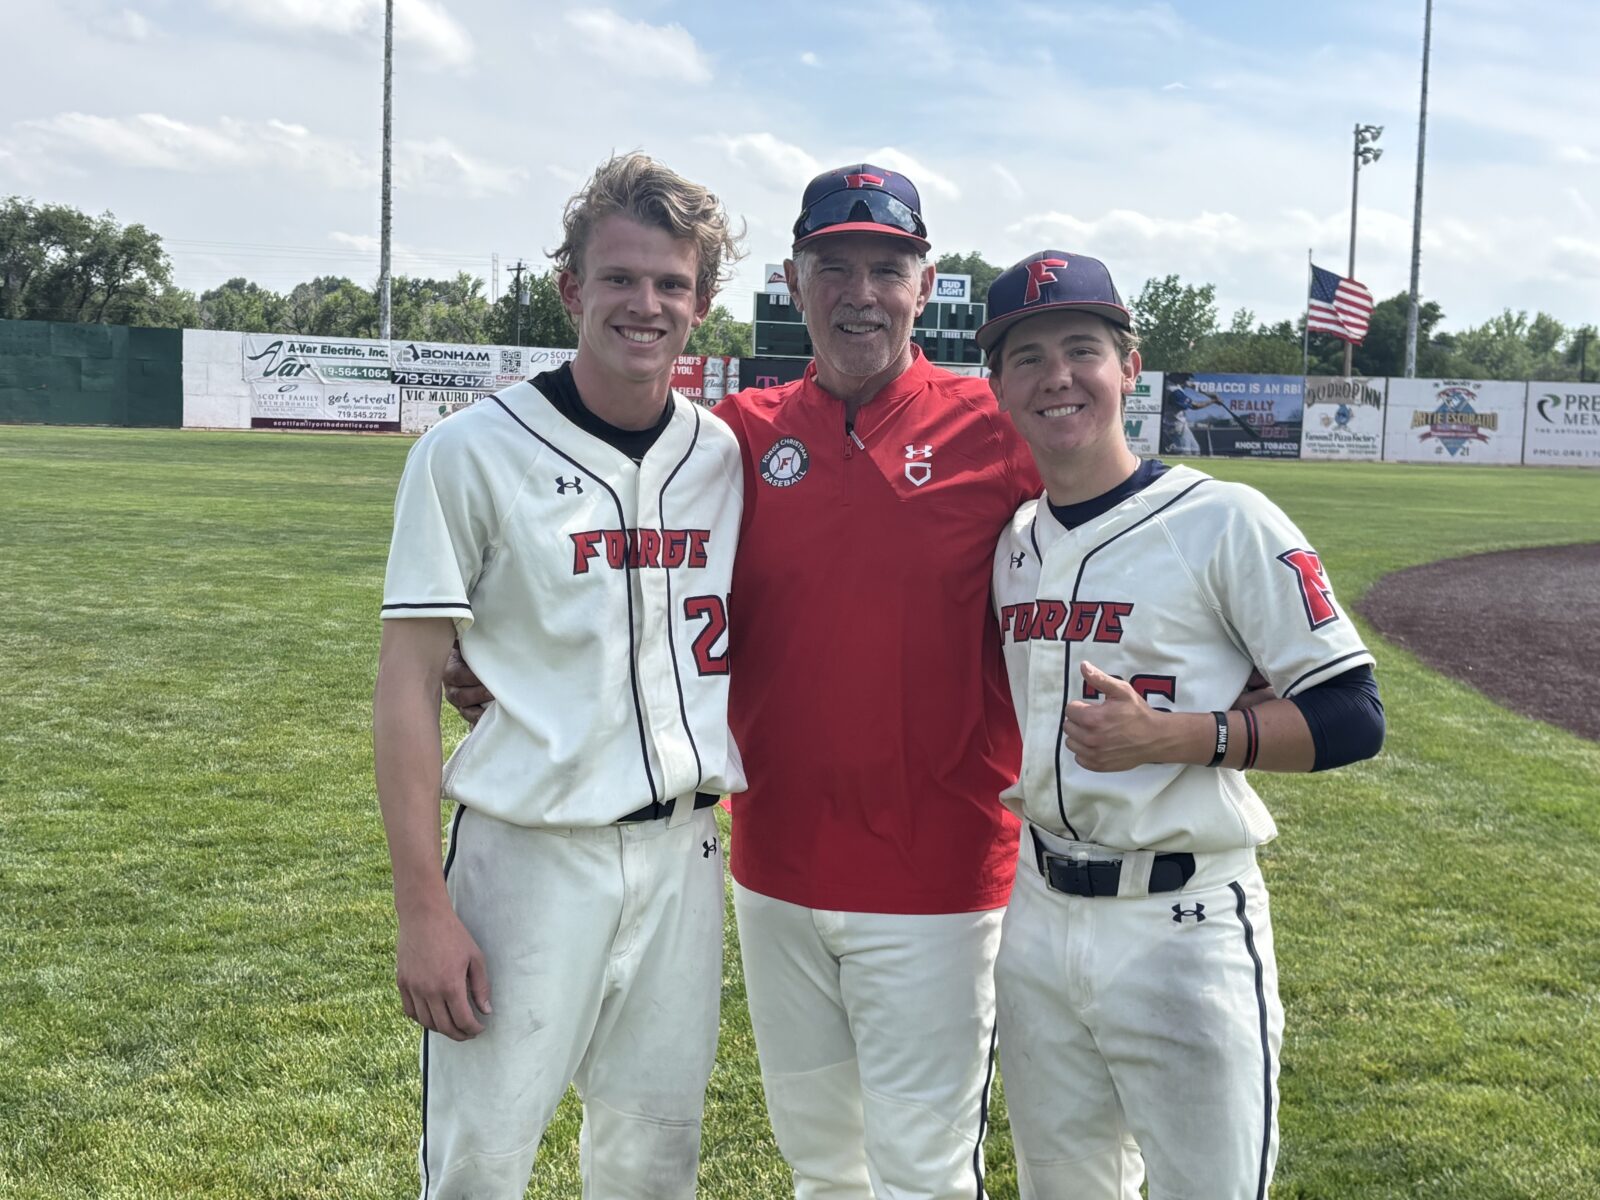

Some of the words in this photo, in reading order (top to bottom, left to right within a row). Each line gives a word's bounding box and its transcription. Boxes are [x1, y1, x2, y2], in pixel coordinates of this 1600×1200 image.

[942, 280, 961, 288] BUD
[1024, 258, 1068, 305] F
[938, 288, 964, 296] LIGHT
[288, 343, 317, 354] A-Var
[320, 345, 365, 358] Electric,
[368, 347, 388, 357] Inc.
[421, 350, 490, 361] BONHAM
[550, 351, 577, 360] SCOT
[421, 359, 490, 368] CONSTRUCTION
[678, 356, 702, 366] BUD'S
[319, 367, 388, 378] 19-564-1064
[677, 366, 695, 375] YOU.
[394, 373, 494, 387] 719-647-6478
[1195, 382, 1246, 394] TOBACCO
[1249, 383, 1260, 394] IS
[1264, 384, 1280, 394] AN
[1283, 384, 1301, 395] RBI
[328, 392, 349, 406] get
[353, 394, 395, 405] wired!
[405, 390, 425, 401] VIC
[429, 391, 469, 403] MAURO
[1361, 386, 1382, 411] INN
[1230, 400, 1275, 411] REALLY
[338, 411, 387, 419] 719.545.2722
[1248, 413, 1274, 425] BAD
[1411, 410, 1444, 429] ARTIE
[273, 421, 380, 429] scottfamilyorthodontics.com
[761, 442, 780, 463] FORGE
[780, 438, 808, 459] CHRISTIAN
[1235, 441, 1261, 450] KNOCK
[1263, 442, 1298, 451] TOBACCO
[779, 457, 792, 471] F
[761, 470, 807, 487] BASEBALL
[568, 527, 711, 575] FORGE
[1001, 599, 1134, 646] FORGE
[683, 593, 731, 677] 2
[1218, 724, 1228, 744] WHAT
[1217, 744, 1227, 753] SO
